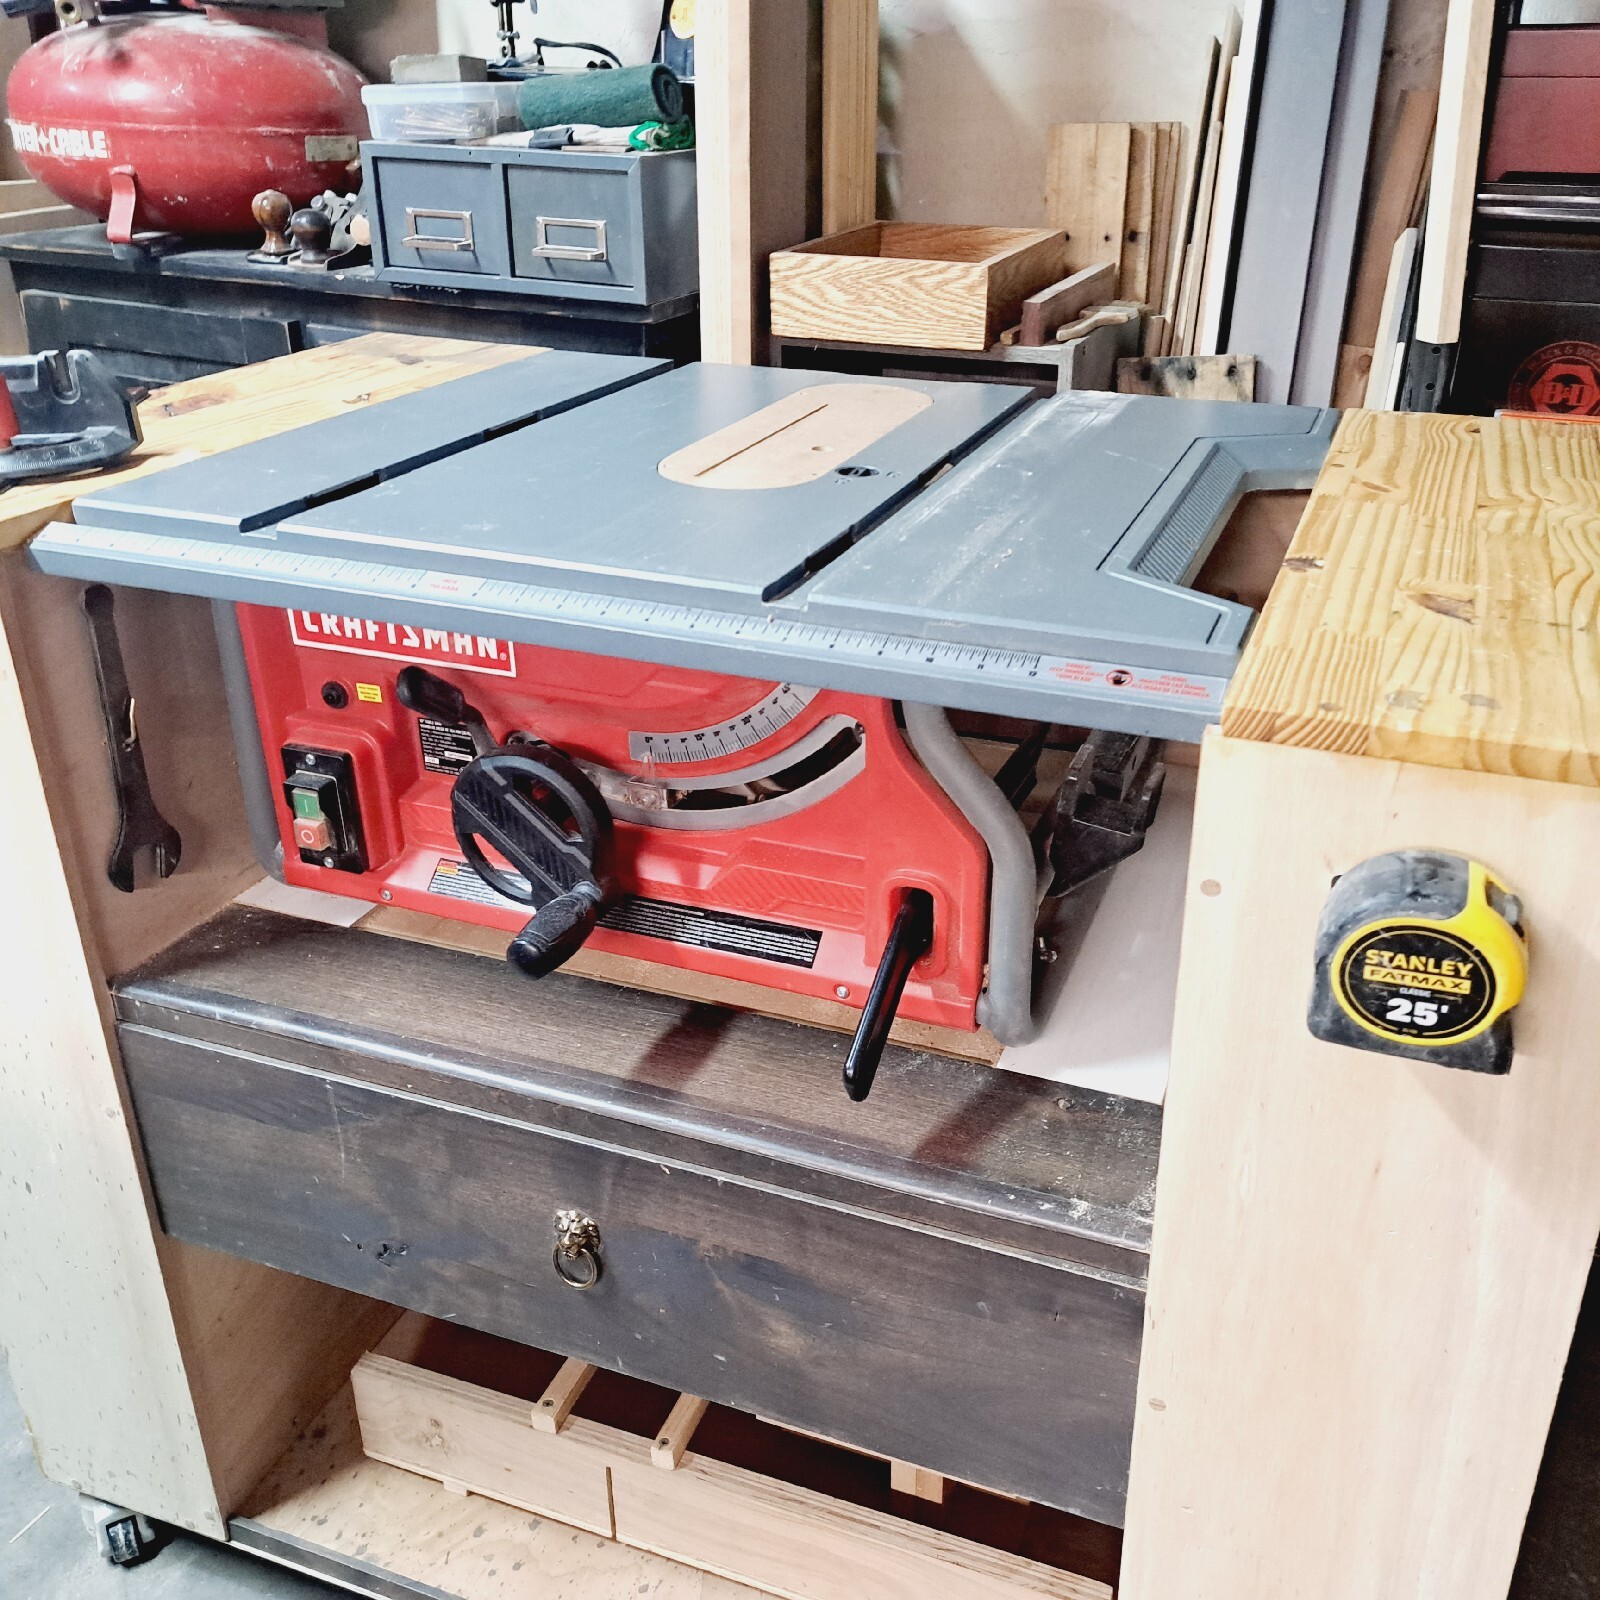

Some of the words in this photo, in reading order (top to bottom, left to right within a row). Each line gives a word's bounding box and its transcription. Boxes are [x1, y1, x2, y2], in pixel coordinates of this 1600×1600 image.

[302, 609, 499, 660] CRAFTSMAN
[1364, 949, 1474, 977] STANLEY
[1369, 969, 1464, 991] FATMAX
[1385, 997, 1450, 1026] 25'
